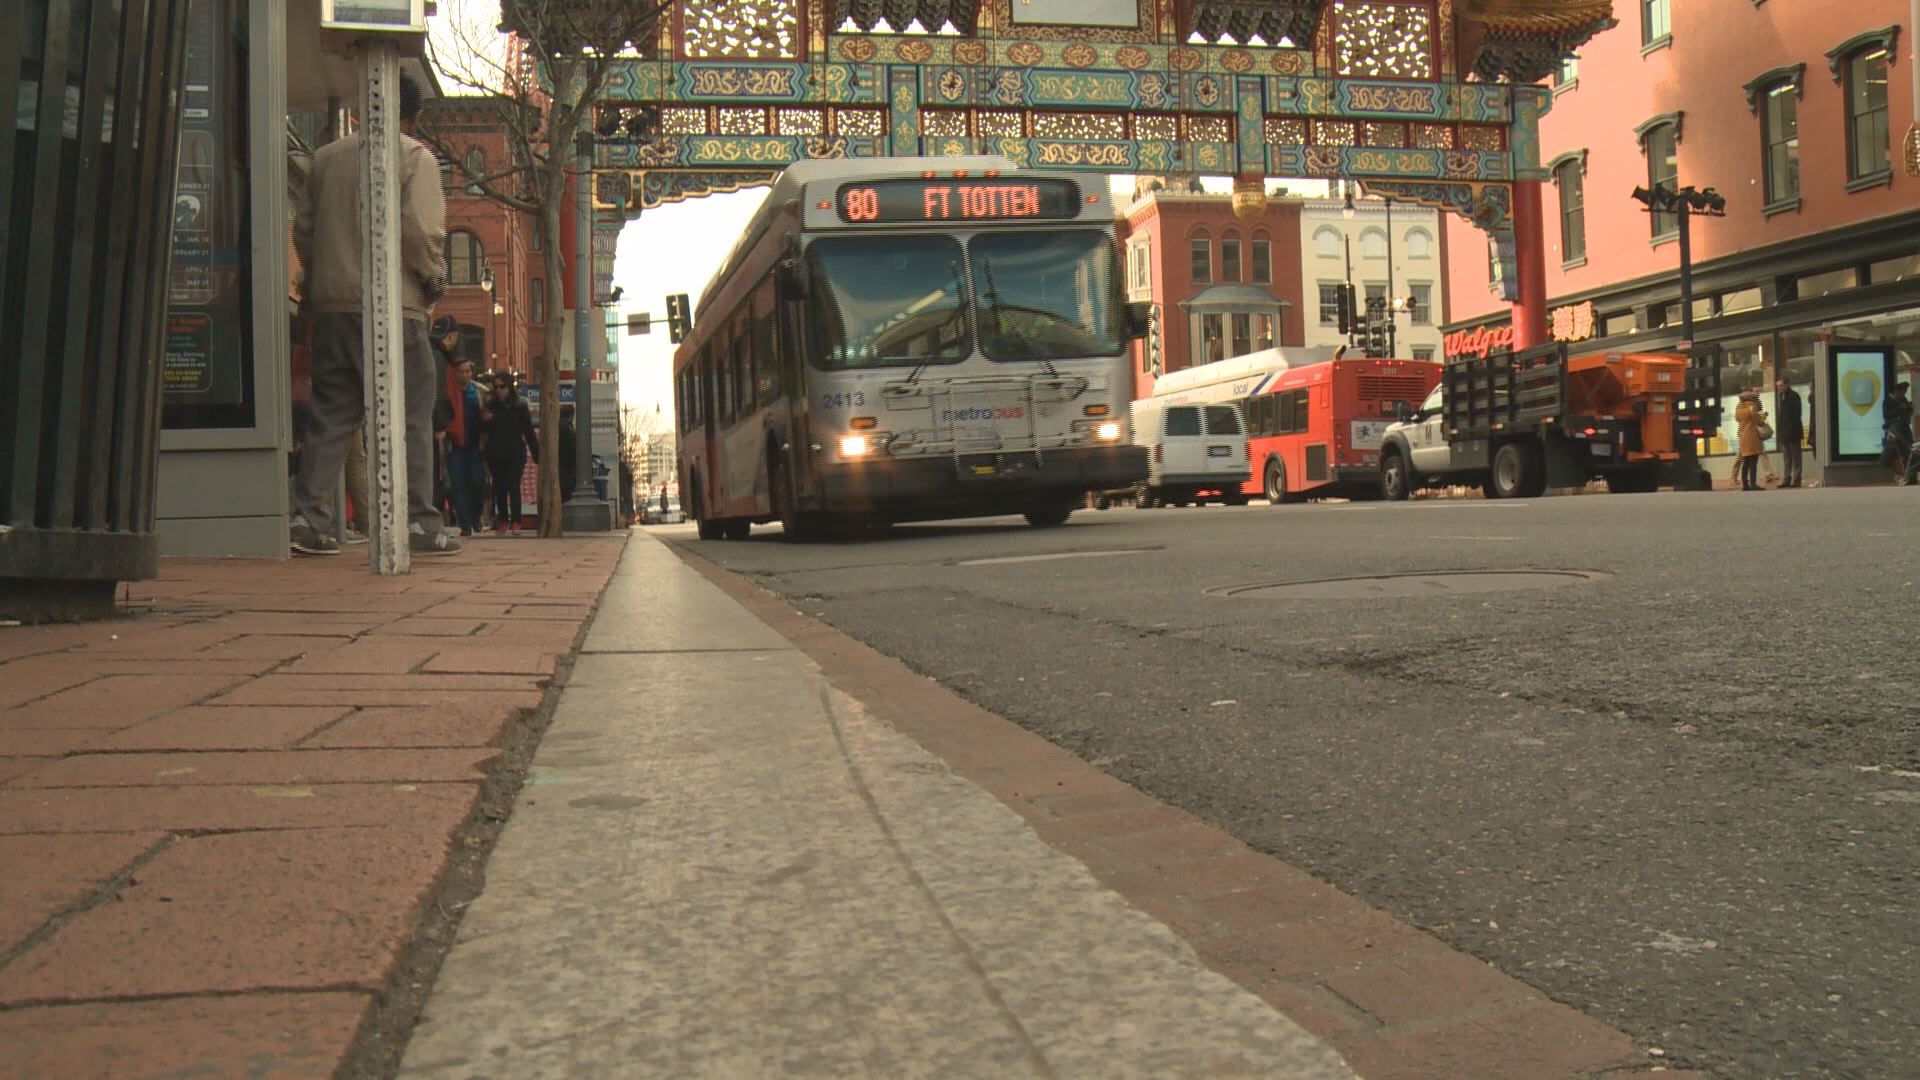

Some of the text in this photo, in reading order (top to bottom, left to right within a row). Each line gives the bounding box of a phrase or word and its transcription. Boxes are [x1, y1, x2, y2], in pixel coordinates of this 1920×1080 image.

[847, 185, 1040, 220] 80 FT TOTTEN
[562, 388, 573, 397] DC
[1233, 382, 1249, 395] local
[824, 391, 865, 408] 2413
